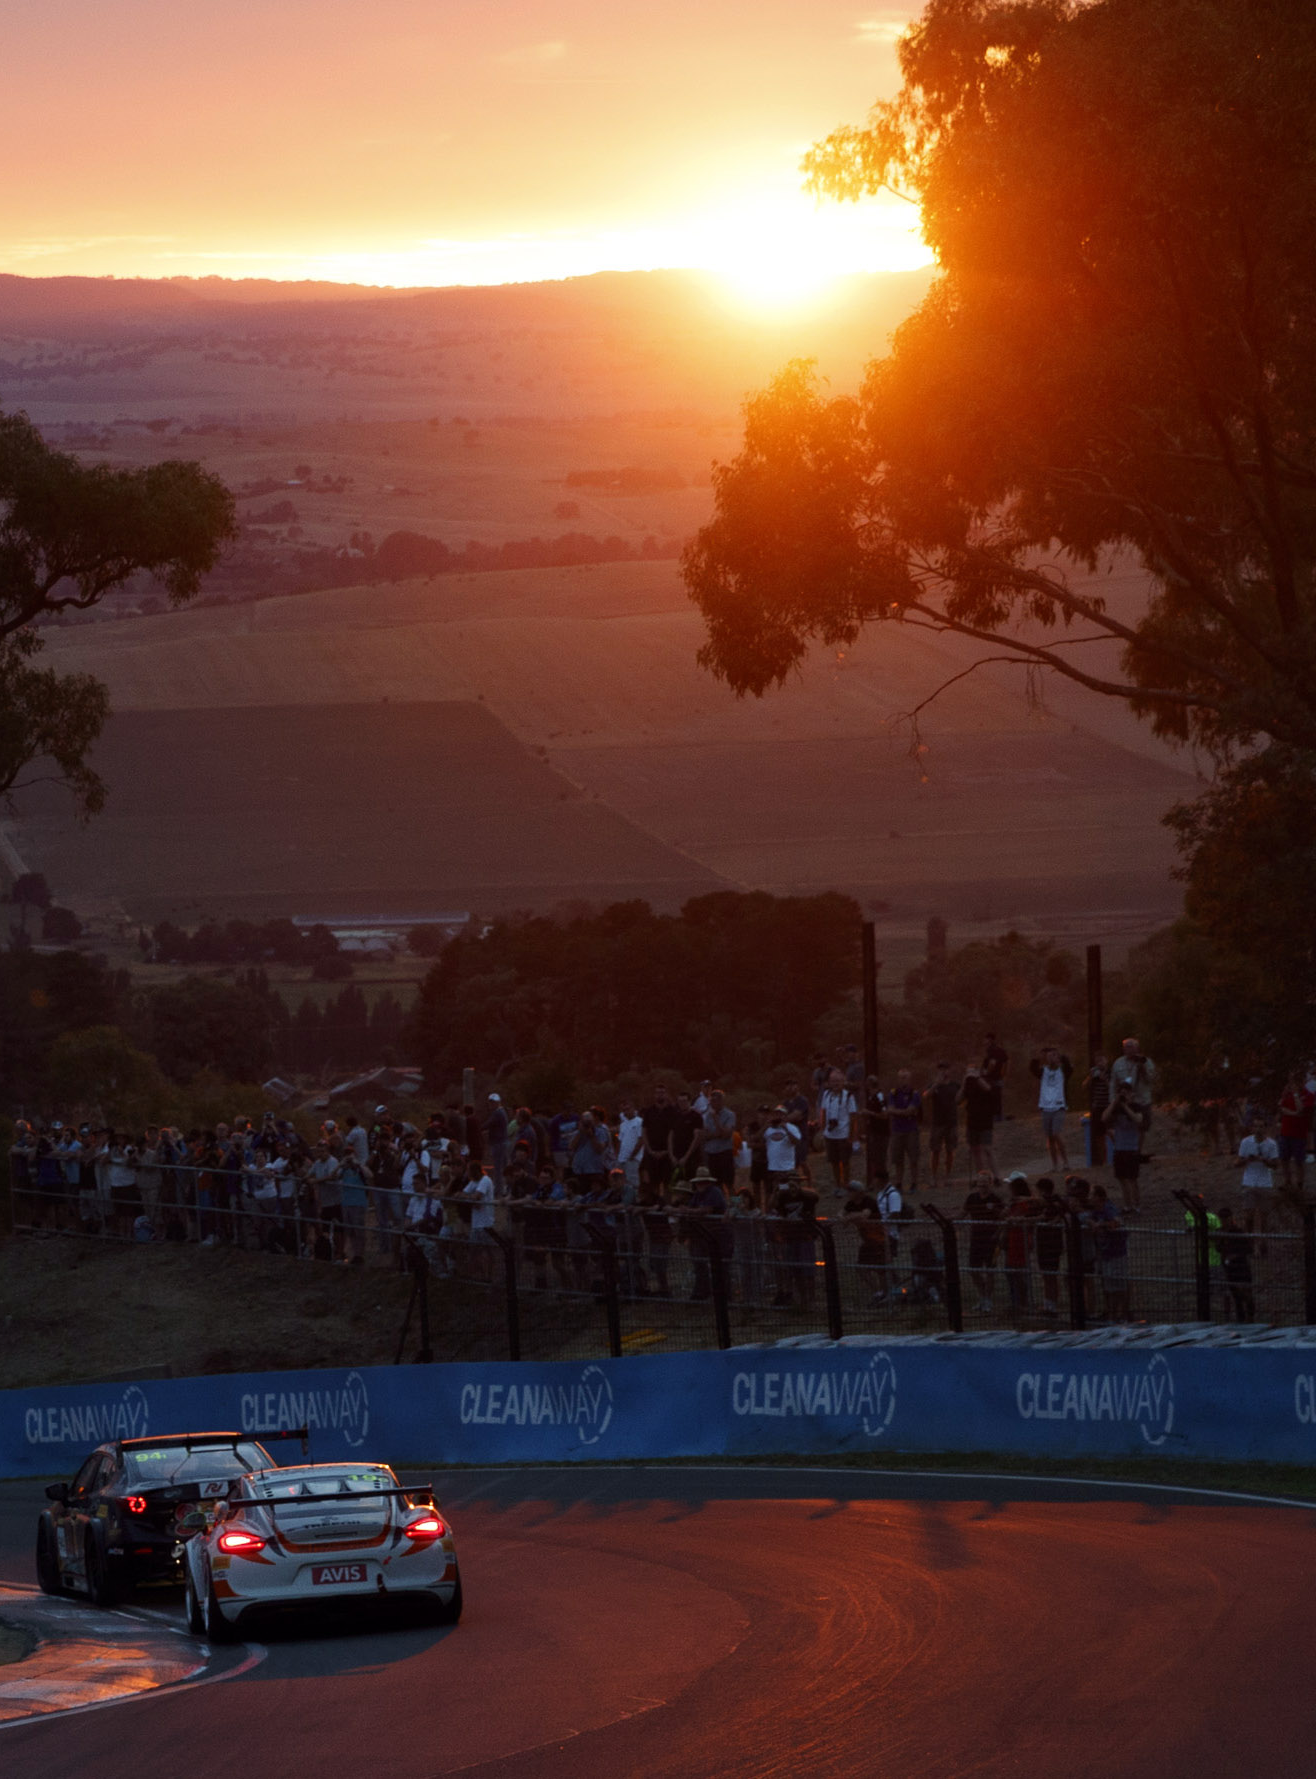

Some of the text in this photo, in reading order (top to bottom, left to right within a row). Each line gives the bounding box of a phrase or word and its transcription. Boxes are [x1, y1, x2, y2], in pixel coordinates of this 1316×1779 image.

[240, 1388, 361, 1431] CLEANAWAY
[461, 1382, 603, 1425] CLEANAWAY
[732, 1371, 886, 1416] CLEANAWAY
[1016, 1372, 1166, 1421] CLEANAWAY
[25, 1401, 141, 1444] CLEANAWAY
[319, 1565, 362, 1583] AVIS
